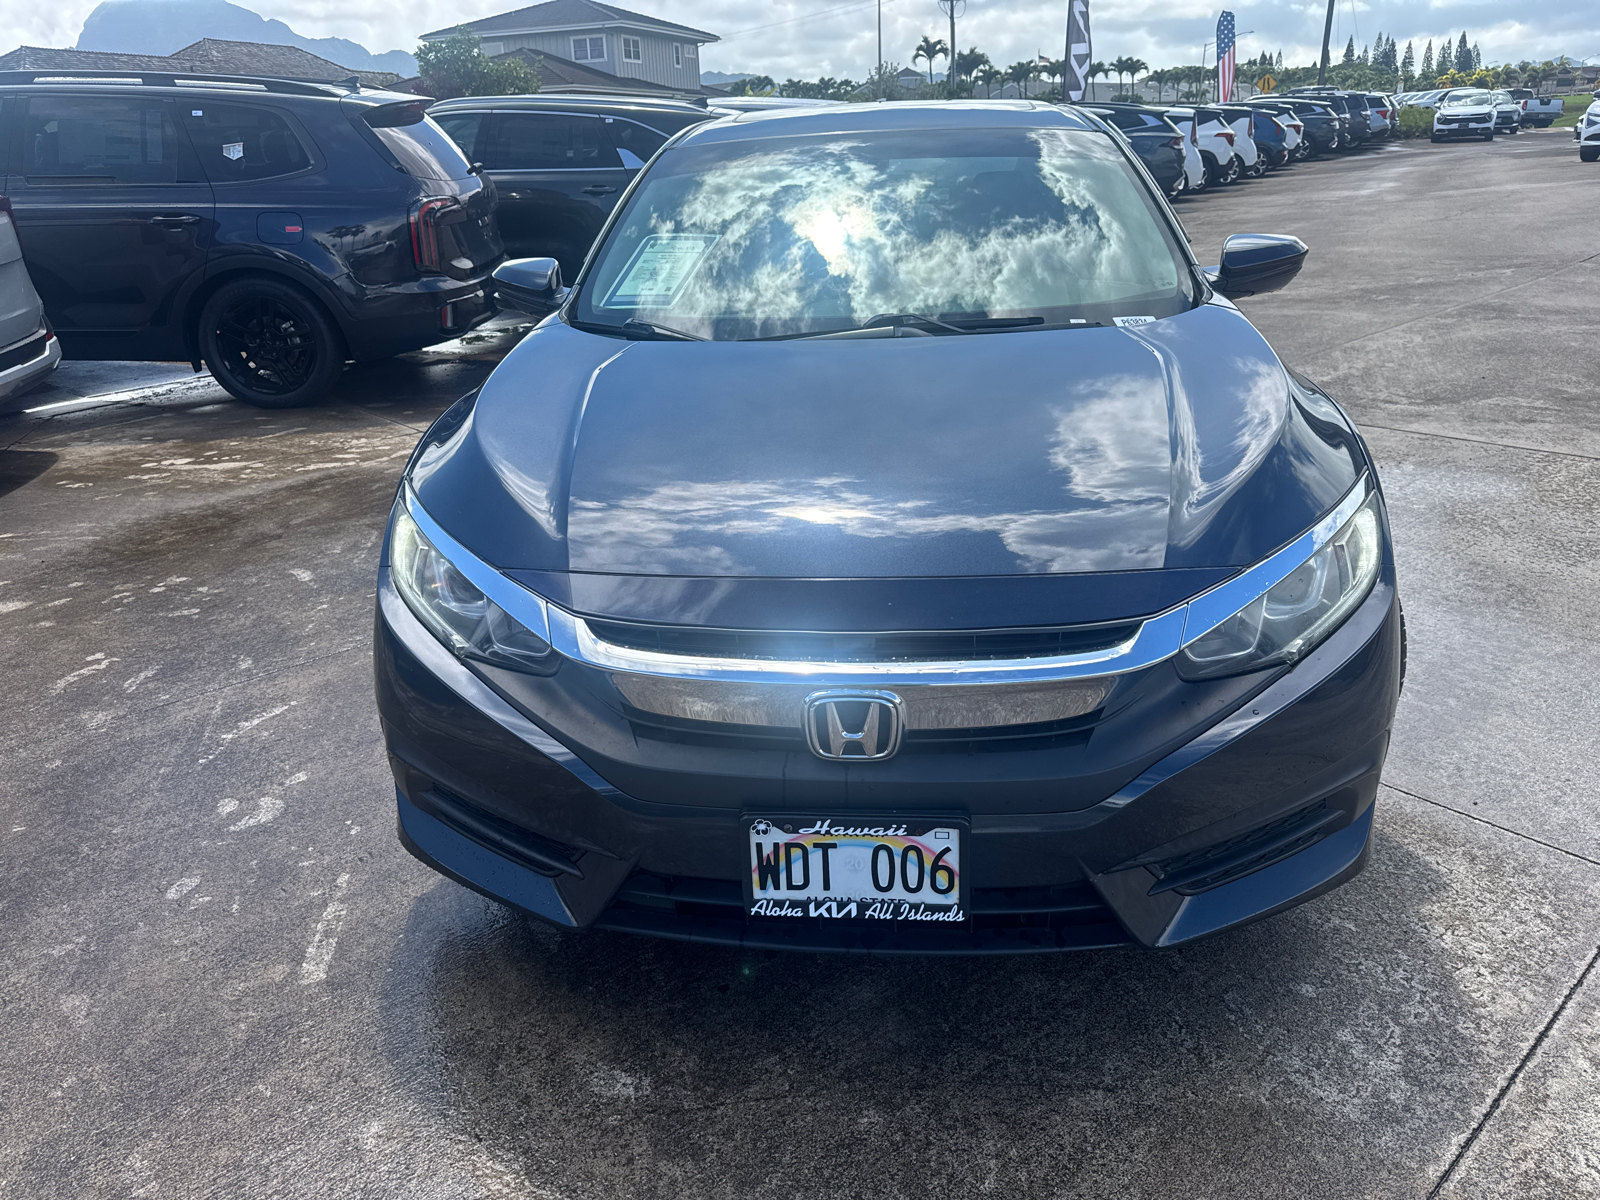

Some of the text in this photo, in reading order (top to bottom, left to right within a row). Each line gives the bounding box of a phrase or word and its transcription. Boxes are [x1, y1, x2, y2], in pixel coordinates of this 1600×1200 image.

[799, 819, 907, 837] Hawaii
[756, 842, 955, 894] WDT 006
[750, 900, 965, 922] Aloha KIA All Islands
